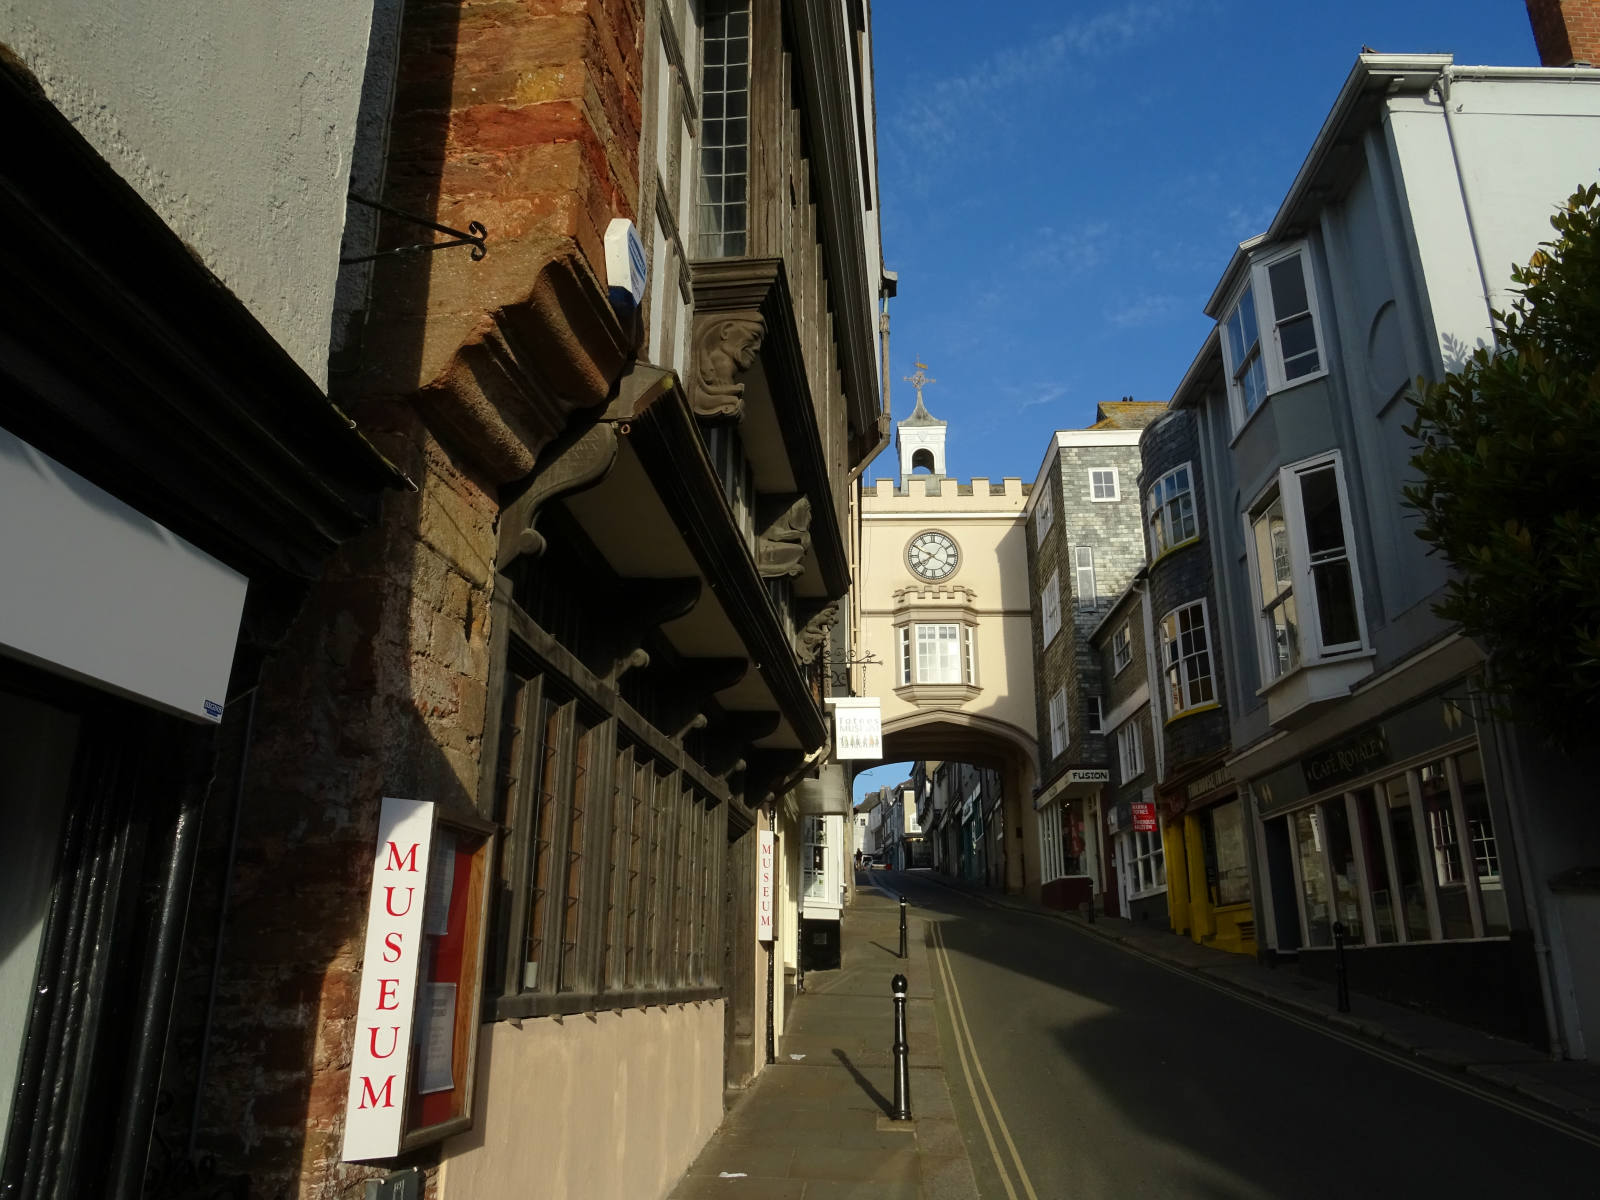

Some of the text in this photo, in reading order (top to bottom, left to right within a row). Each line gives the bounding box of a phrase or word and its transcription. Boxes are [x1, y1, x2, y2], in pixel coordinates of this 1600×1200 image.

[1072, 772, 1107, 780] FUSION
[1337, 740, 1377, 772] ROYALE
[761, 844, 771, 926] MUSEUM
[357, 841, 420, 1109] MUSEUM
